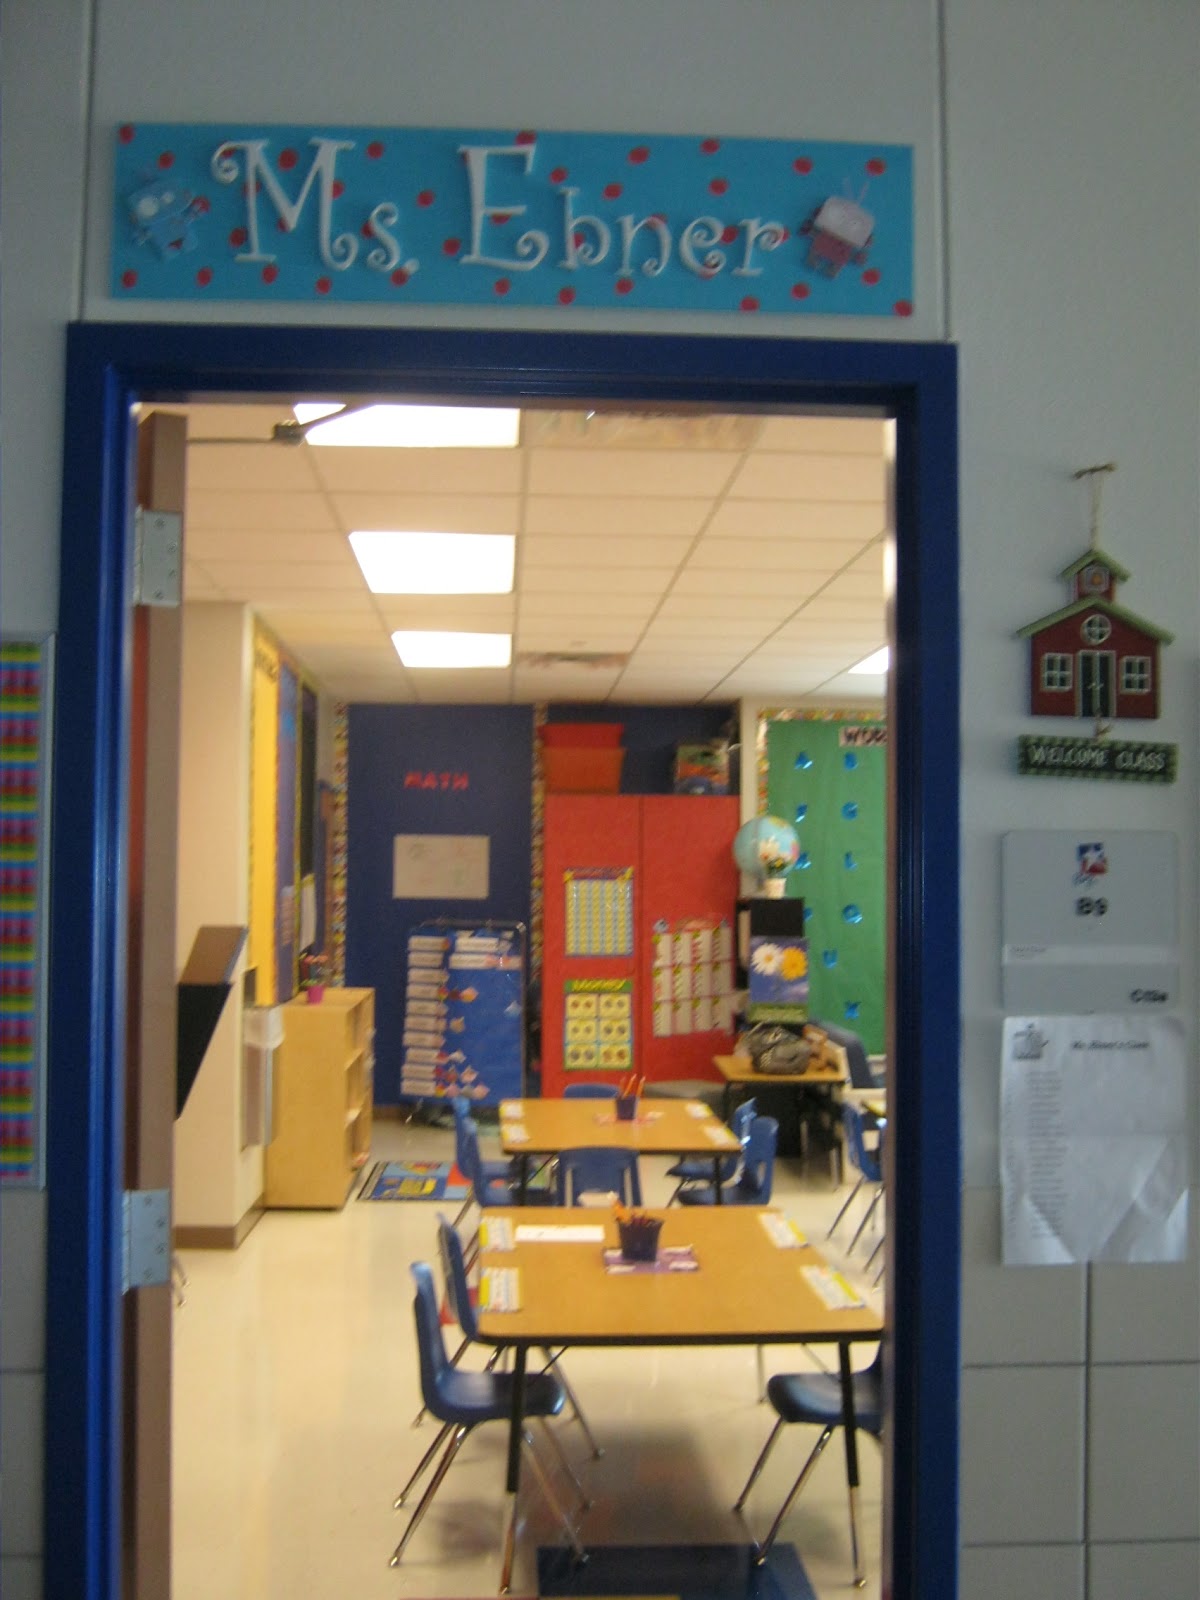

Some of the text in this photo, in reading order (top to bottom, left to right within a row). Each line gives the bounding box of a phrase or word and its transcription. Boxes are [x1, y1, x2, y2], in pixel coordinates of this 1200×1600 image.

[211, 137, 787, 278] Ms. Ebner
[1028, 745, 1166, 772] WELCOME CLASS
[403, 770, 469, 791] MATH
